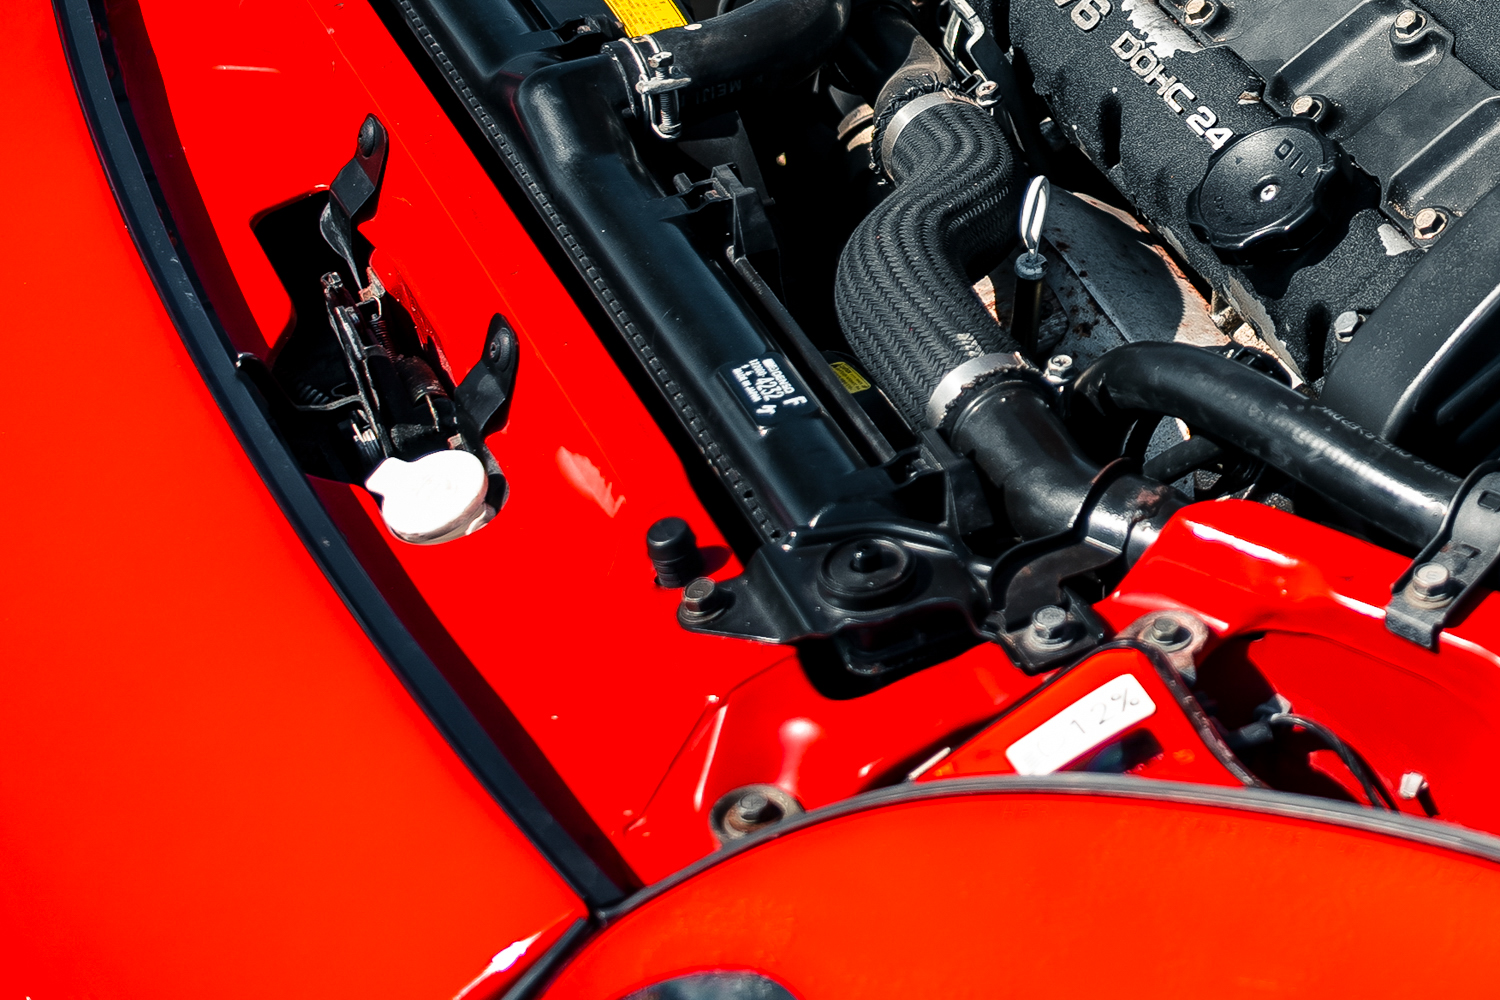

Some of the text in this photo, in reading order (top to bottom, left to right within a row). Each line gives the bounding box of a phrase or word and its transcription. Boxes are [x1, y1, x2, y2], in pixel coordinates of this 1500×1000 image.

[1110, 31, 1234, 151] DOHC 24
[1275, 138, 1313, 180] OIL
